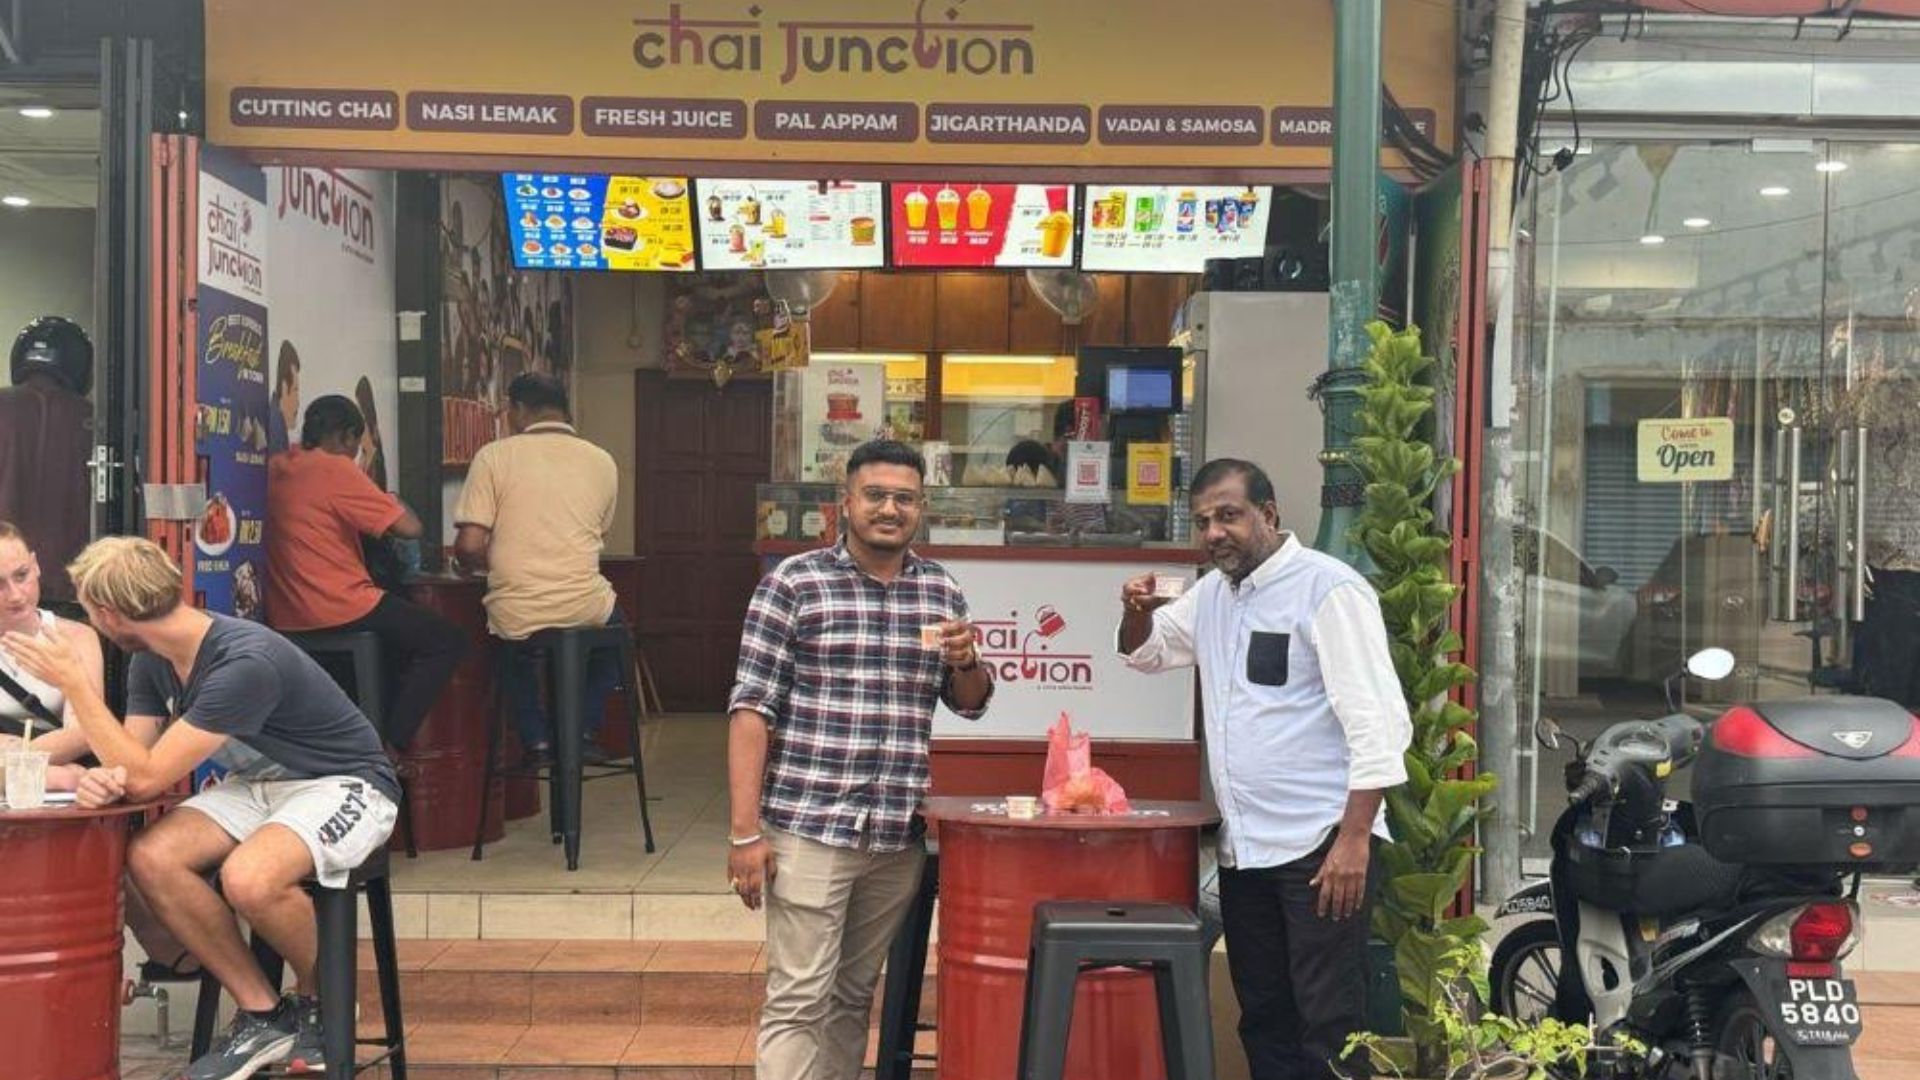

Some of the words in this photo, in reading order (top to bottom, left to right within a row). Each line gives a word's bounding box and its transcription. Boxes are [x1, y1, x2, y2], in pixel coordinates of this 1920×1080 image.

[633, 3, 760, 71] chai
[777, 6, 1034, 84] Junction
[238, 98, 333, 118] CUTTING
[337, 100, 392, 119] CHAI
[421, 103, 475, 121] NASI
[481, 104, 557, 124] LEMAK
[595, 108, 666, 126] FRESH
[671, 110, 733, 128] JUICE
[775, 112, 816, 130] PAL
[820, 113, 898, 131] APPAM
[930, 114, 1086, 134] JIGARTHANDA
[1105, 117, 1161, 133] VADAI
[1165, 117, 1177, 133] &
[1181, 118, 1257, 134] SAMOSA
[207, 237, 263, 289] Junction
[1656, 444, 1716, 475] Open
[1788, 979, 1845, 1002] PLD
[1781, 1001, 1860, 1025] 5840
